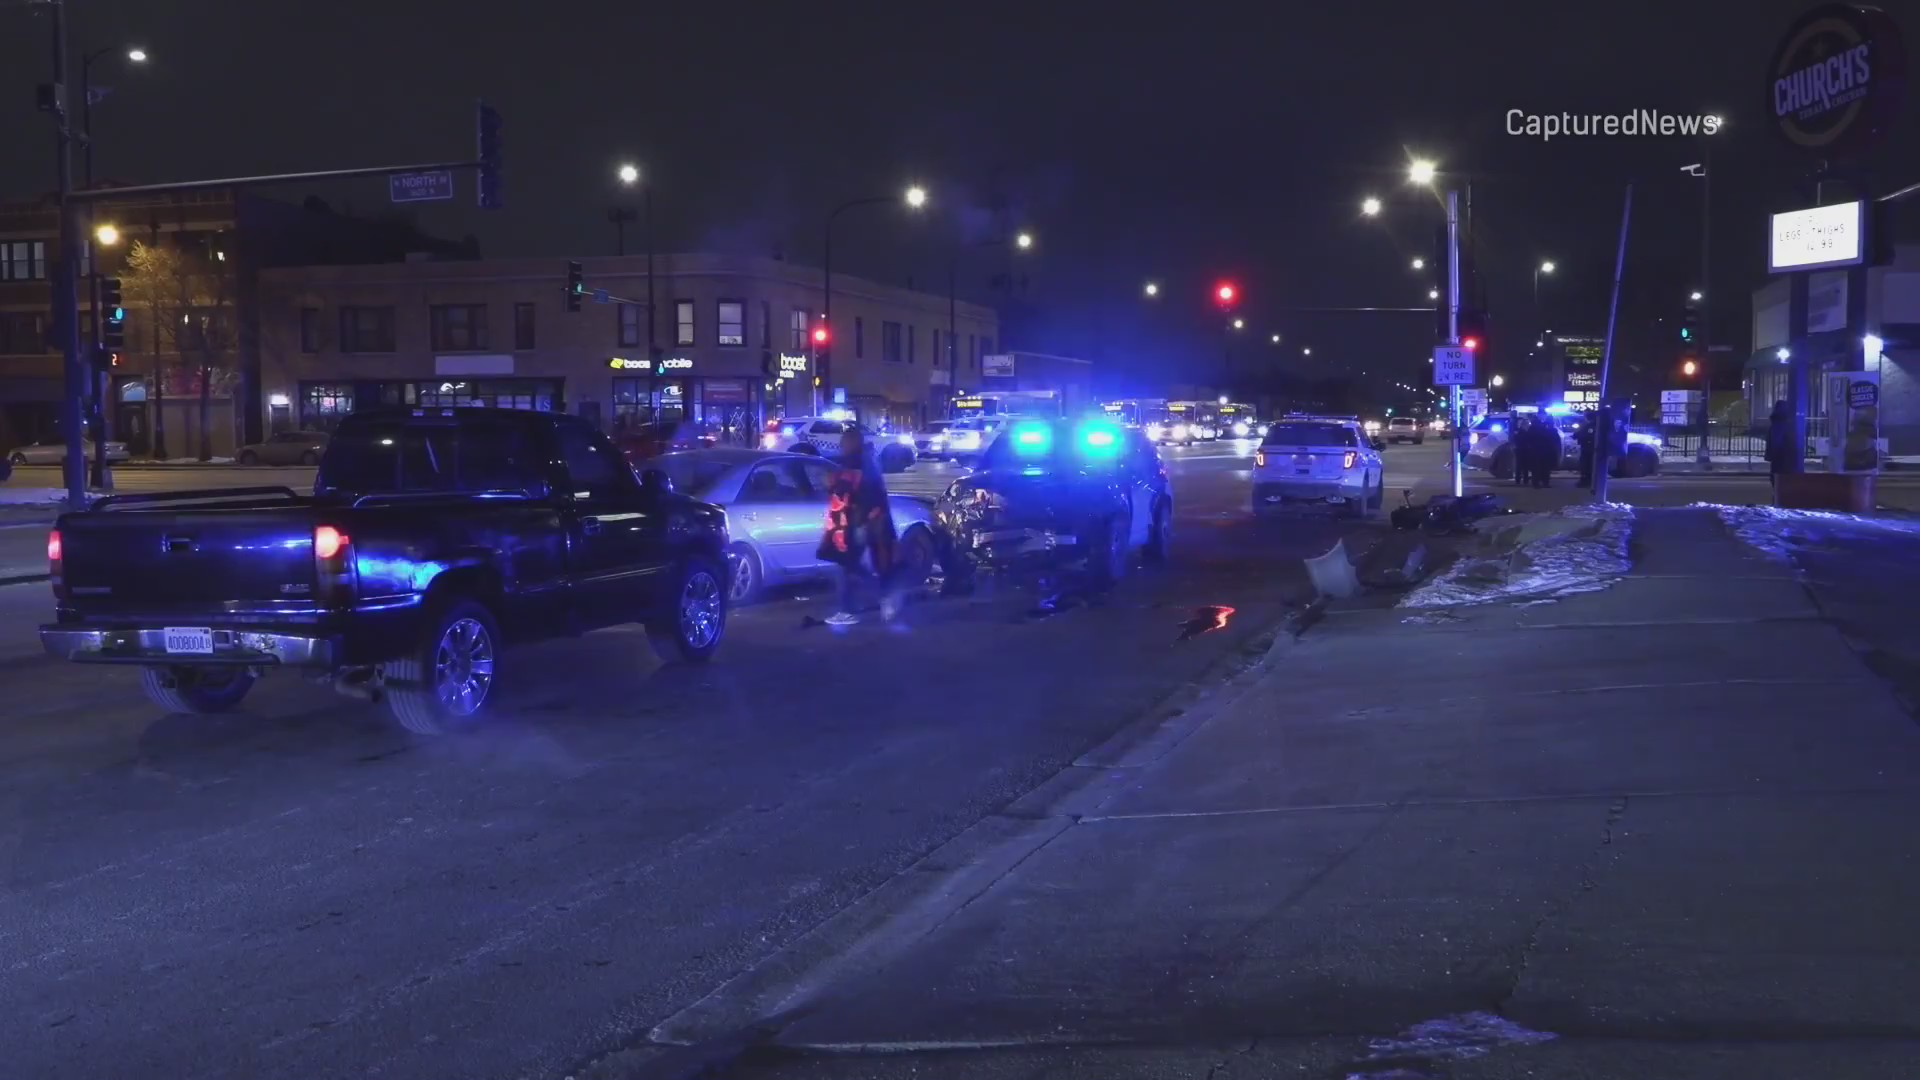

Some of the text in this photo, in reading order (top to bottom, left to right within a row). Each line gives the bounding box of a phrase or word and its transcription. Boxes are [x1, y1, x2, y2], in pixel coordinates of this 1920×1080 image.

[1774, 44, 1870, 117] CHURCH'S
[402, 176, 436, 188] NORTH
[1446, 351, 1462, 359] NO
[781, 352, 806, 371] boost
[1443, 361, 1466, 370] TURN
